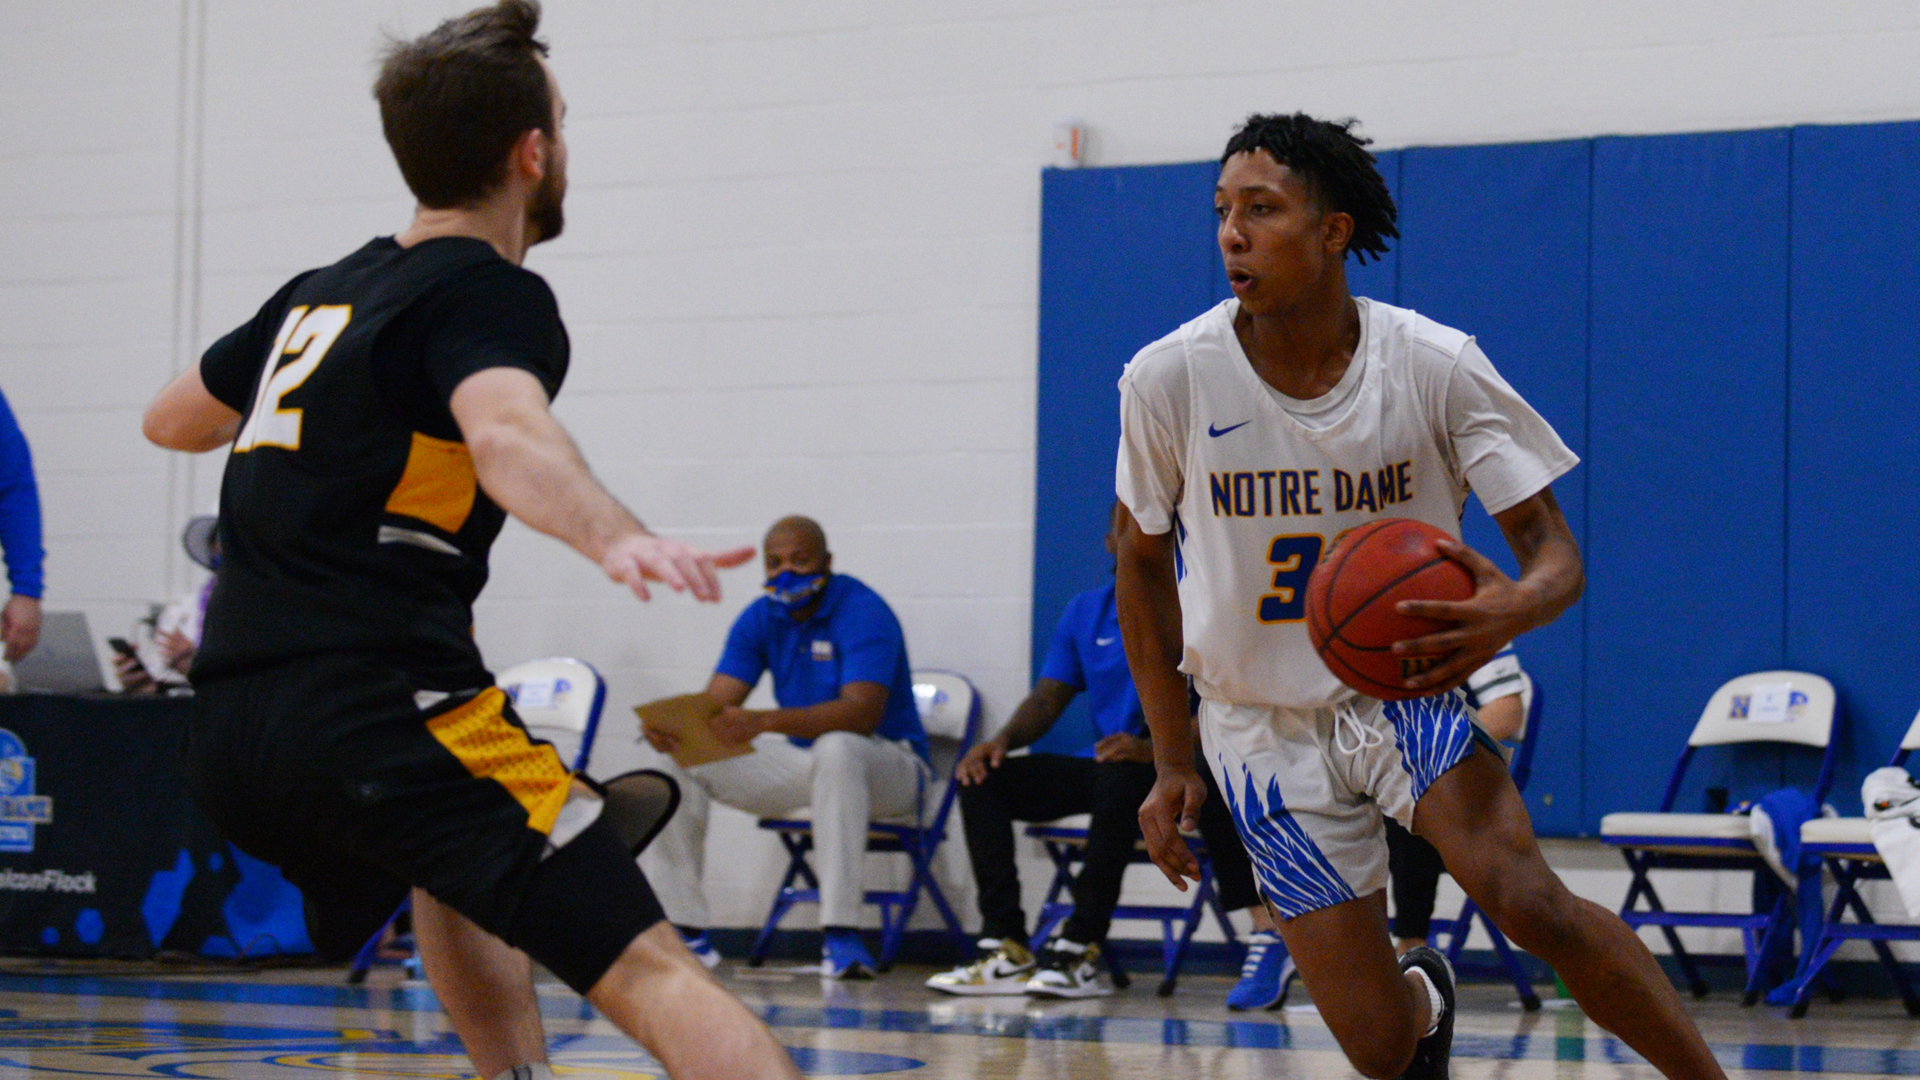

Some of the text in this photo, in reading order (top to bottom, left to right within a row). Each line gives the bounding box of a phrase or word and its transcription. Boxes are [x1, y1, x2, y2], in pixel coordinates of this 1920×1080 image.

[233, 304, 352, 453] 12
[1209, 459, 1413, 517] NOTRE DAME
[1256, 530, 1345, 625] 3
